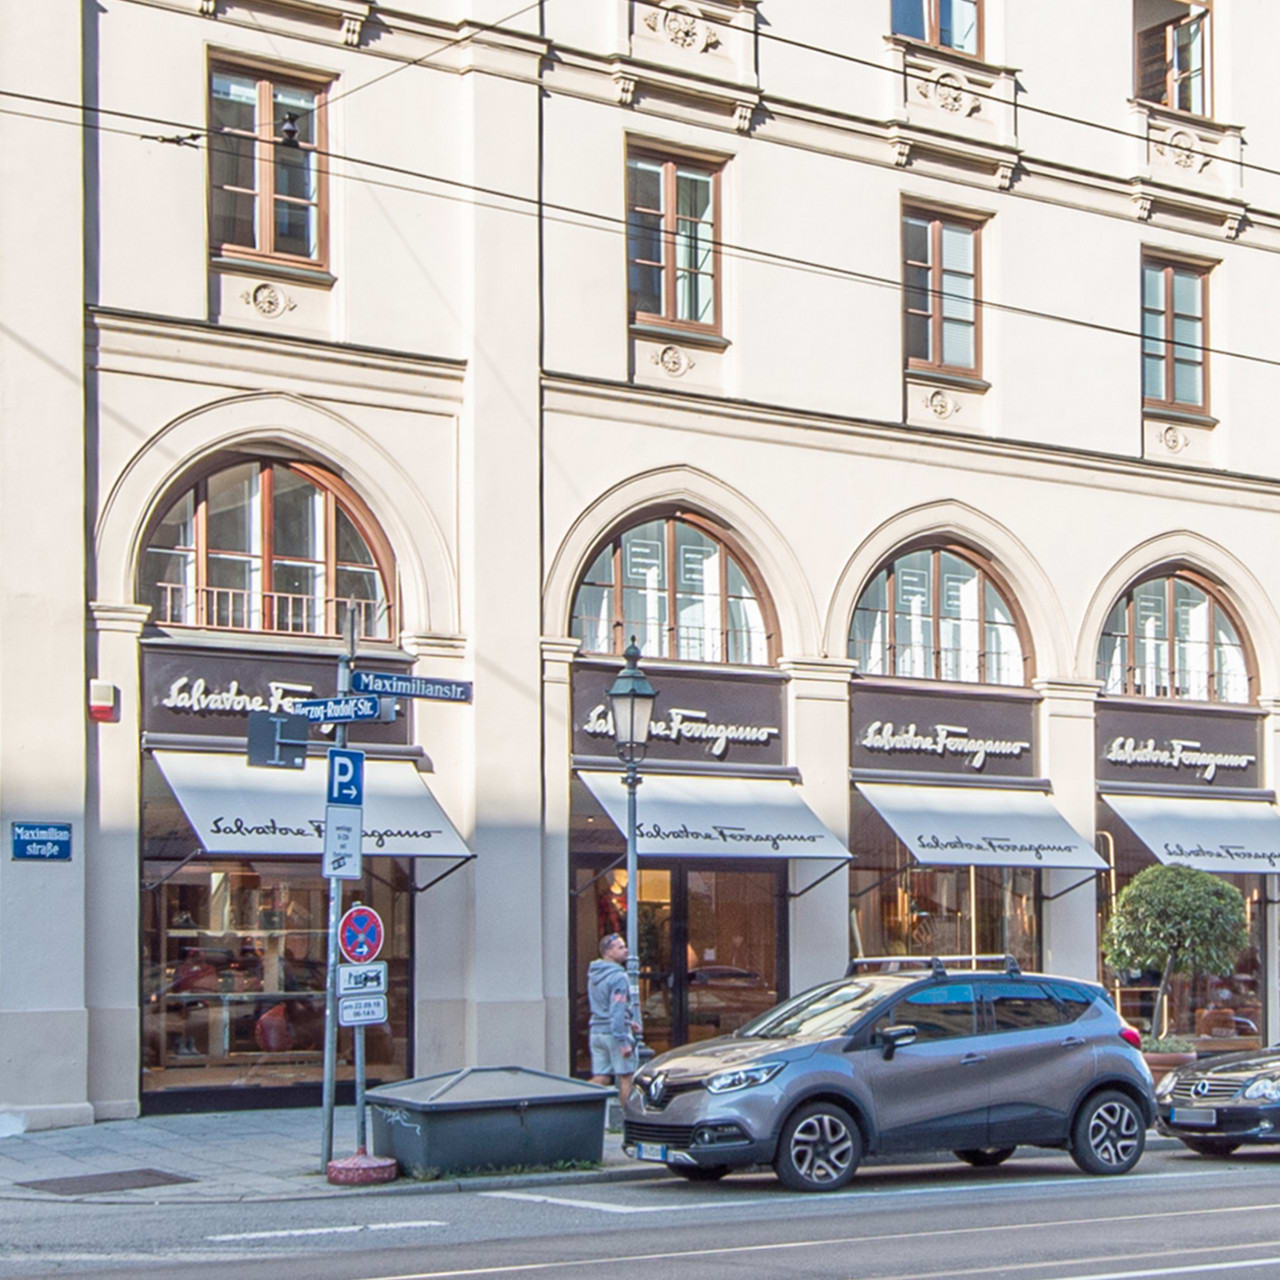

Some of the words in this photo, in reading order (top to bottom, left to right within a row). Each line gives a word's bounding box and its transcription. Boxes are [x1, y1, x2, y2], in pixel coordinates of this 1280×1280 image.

[162, 677, 269, 712] Salvatore
[360, 674, 467, 700] Maximilianstr.
[668, 708, 779, 756] Ferragamo
[860, 721, 938, 751] Salvatore
[934, 724, 1031, 769] Ferragamo
[1107, 736, 1173, 763] Salvatore
[1169, 739, 1256, 780] Ferragamo
[332, 756, 354, 799] P
[210, 817, 312, 838] Salvatore
[635, 822, 716, 841] Salvatore
[712, 825, 824, 851] Ferragamo
[25, 841, 60, 857] straße
[917, 835, 985, 851] Salvatore
[981, 837, 1079, 860] Ferragamo
